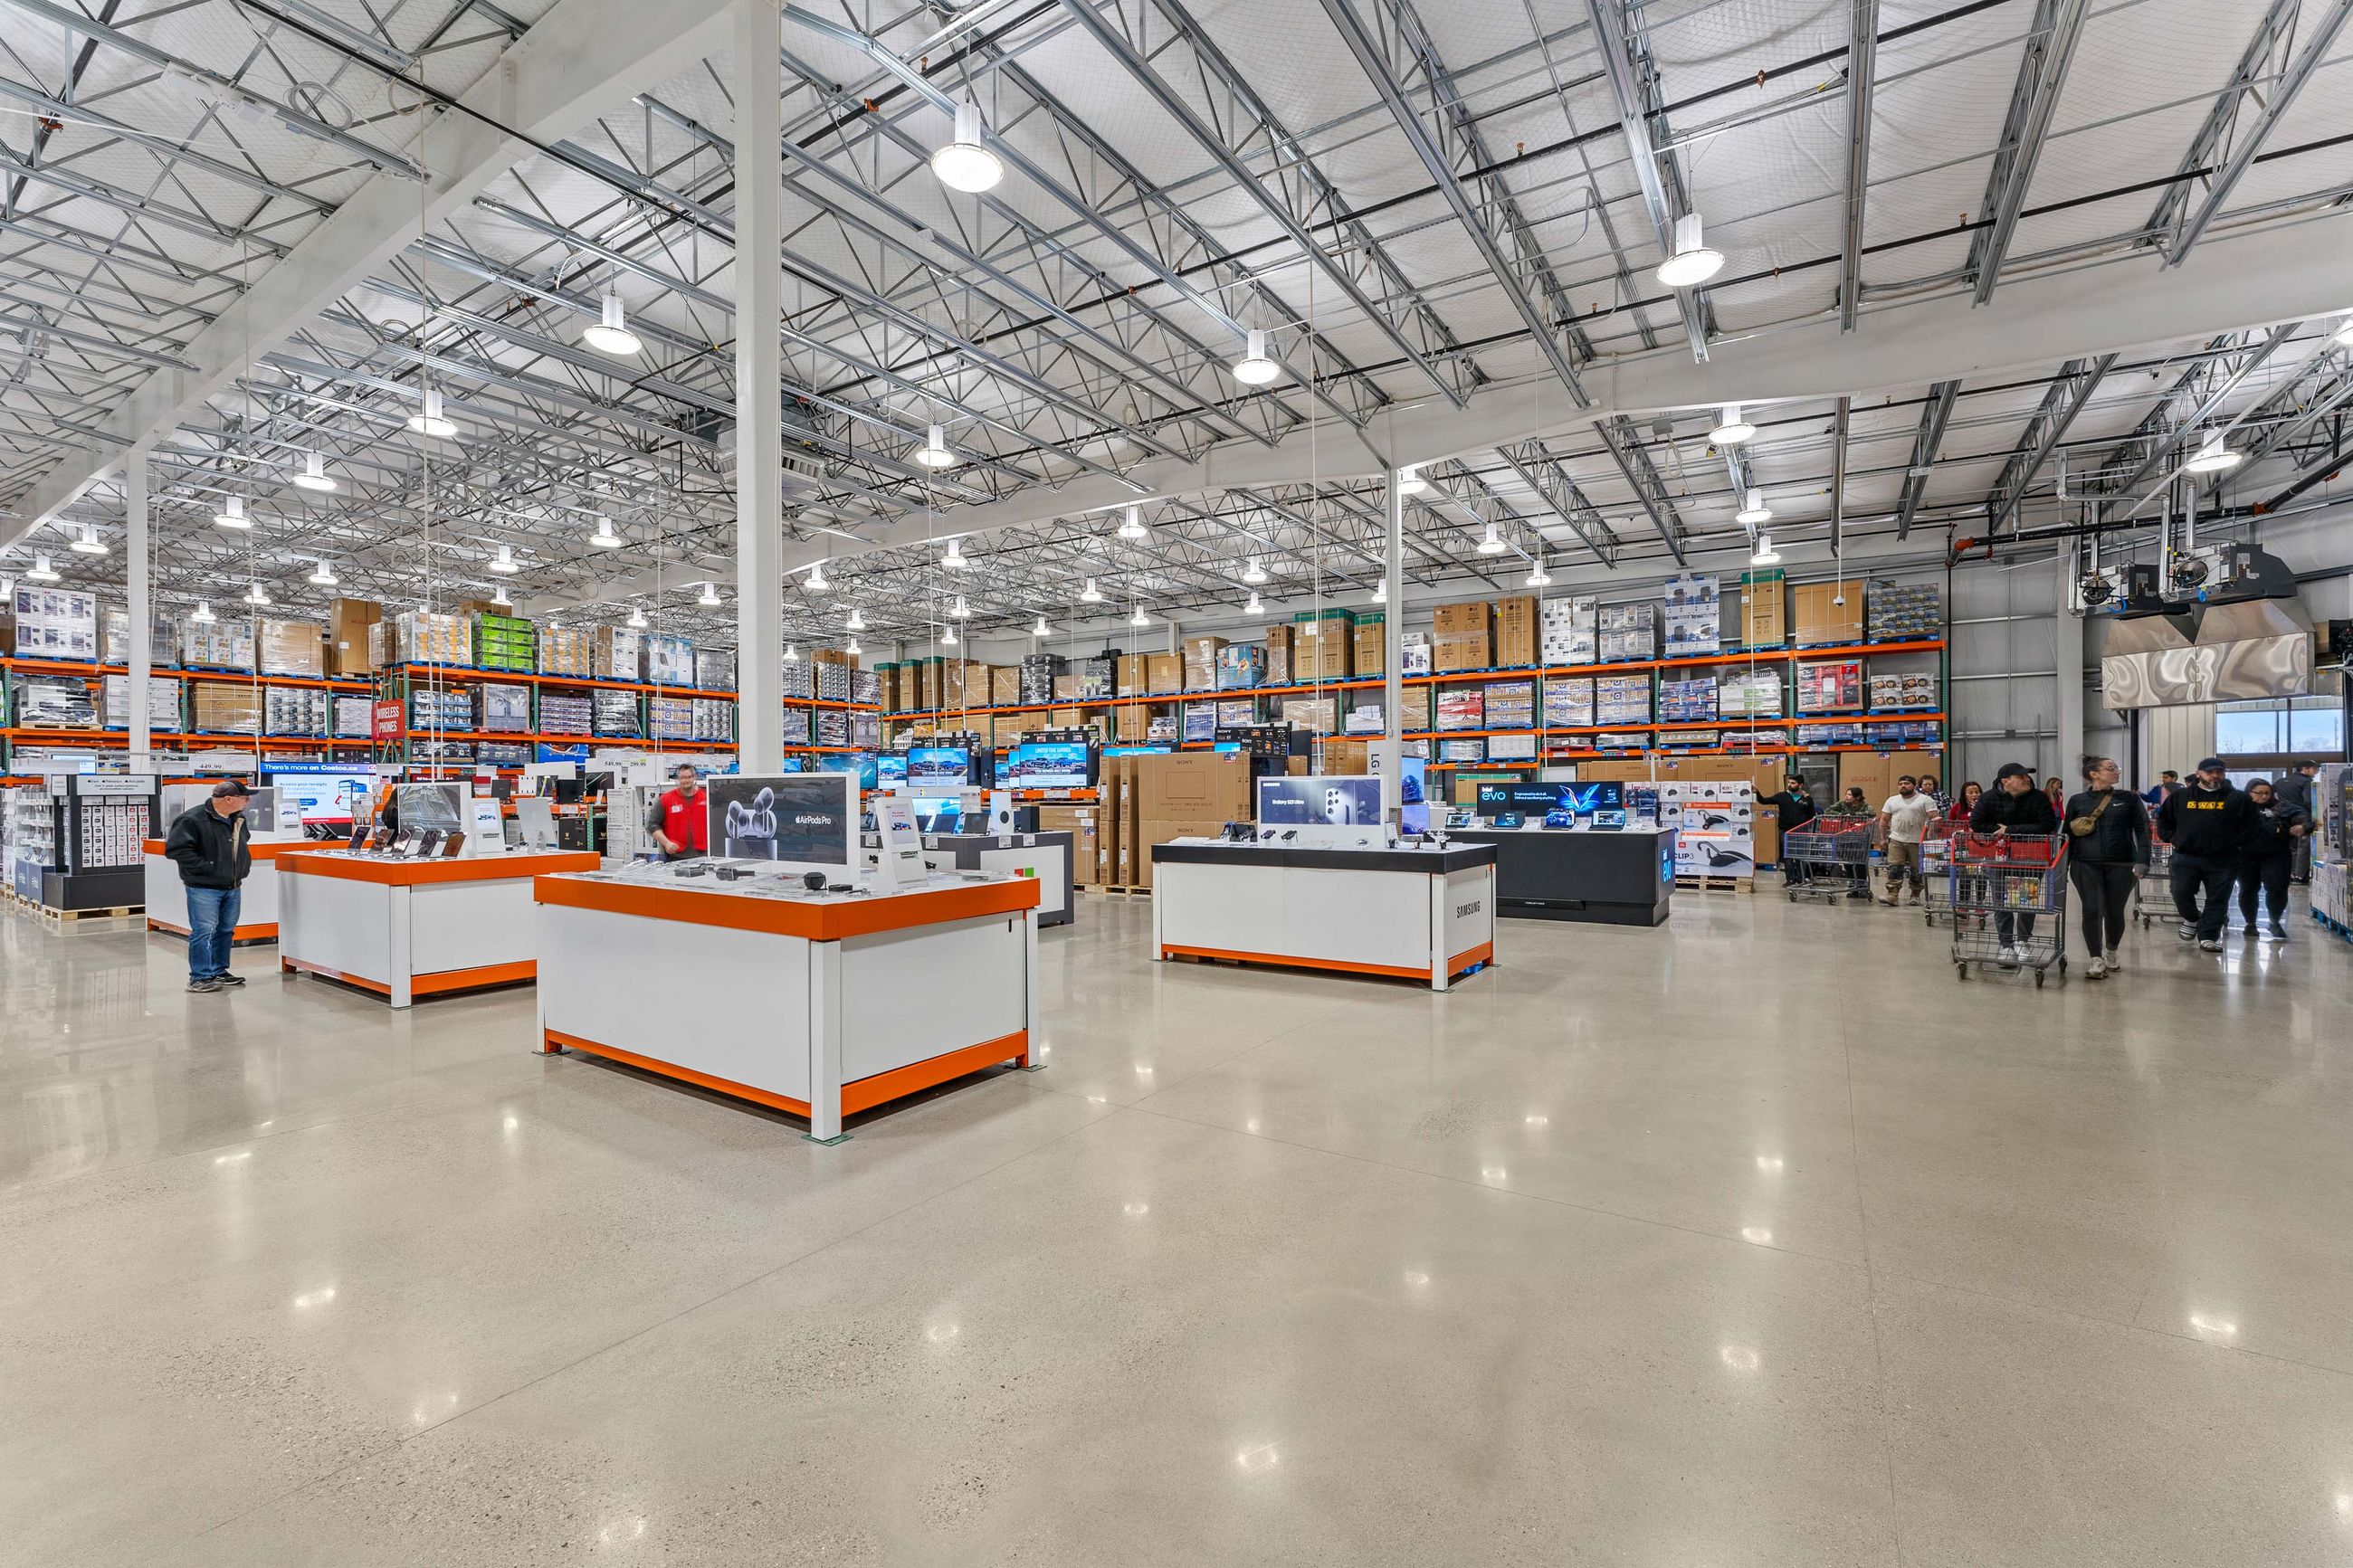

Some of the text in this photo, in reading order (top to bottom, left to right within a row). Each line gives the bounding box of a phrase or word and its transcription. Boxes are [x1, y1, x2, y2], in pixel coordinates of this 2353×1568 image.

[377, 706, 400, 719] WIRELESS
[378, 720, 397, 733] PHONES
[1371, 754, 1380, 768] LG
[1481, 792, 1506, 801] evo
[800, 816, 832, 825] AirPods Pro
[1456, 900, 1481, 919] SAMSUNG
